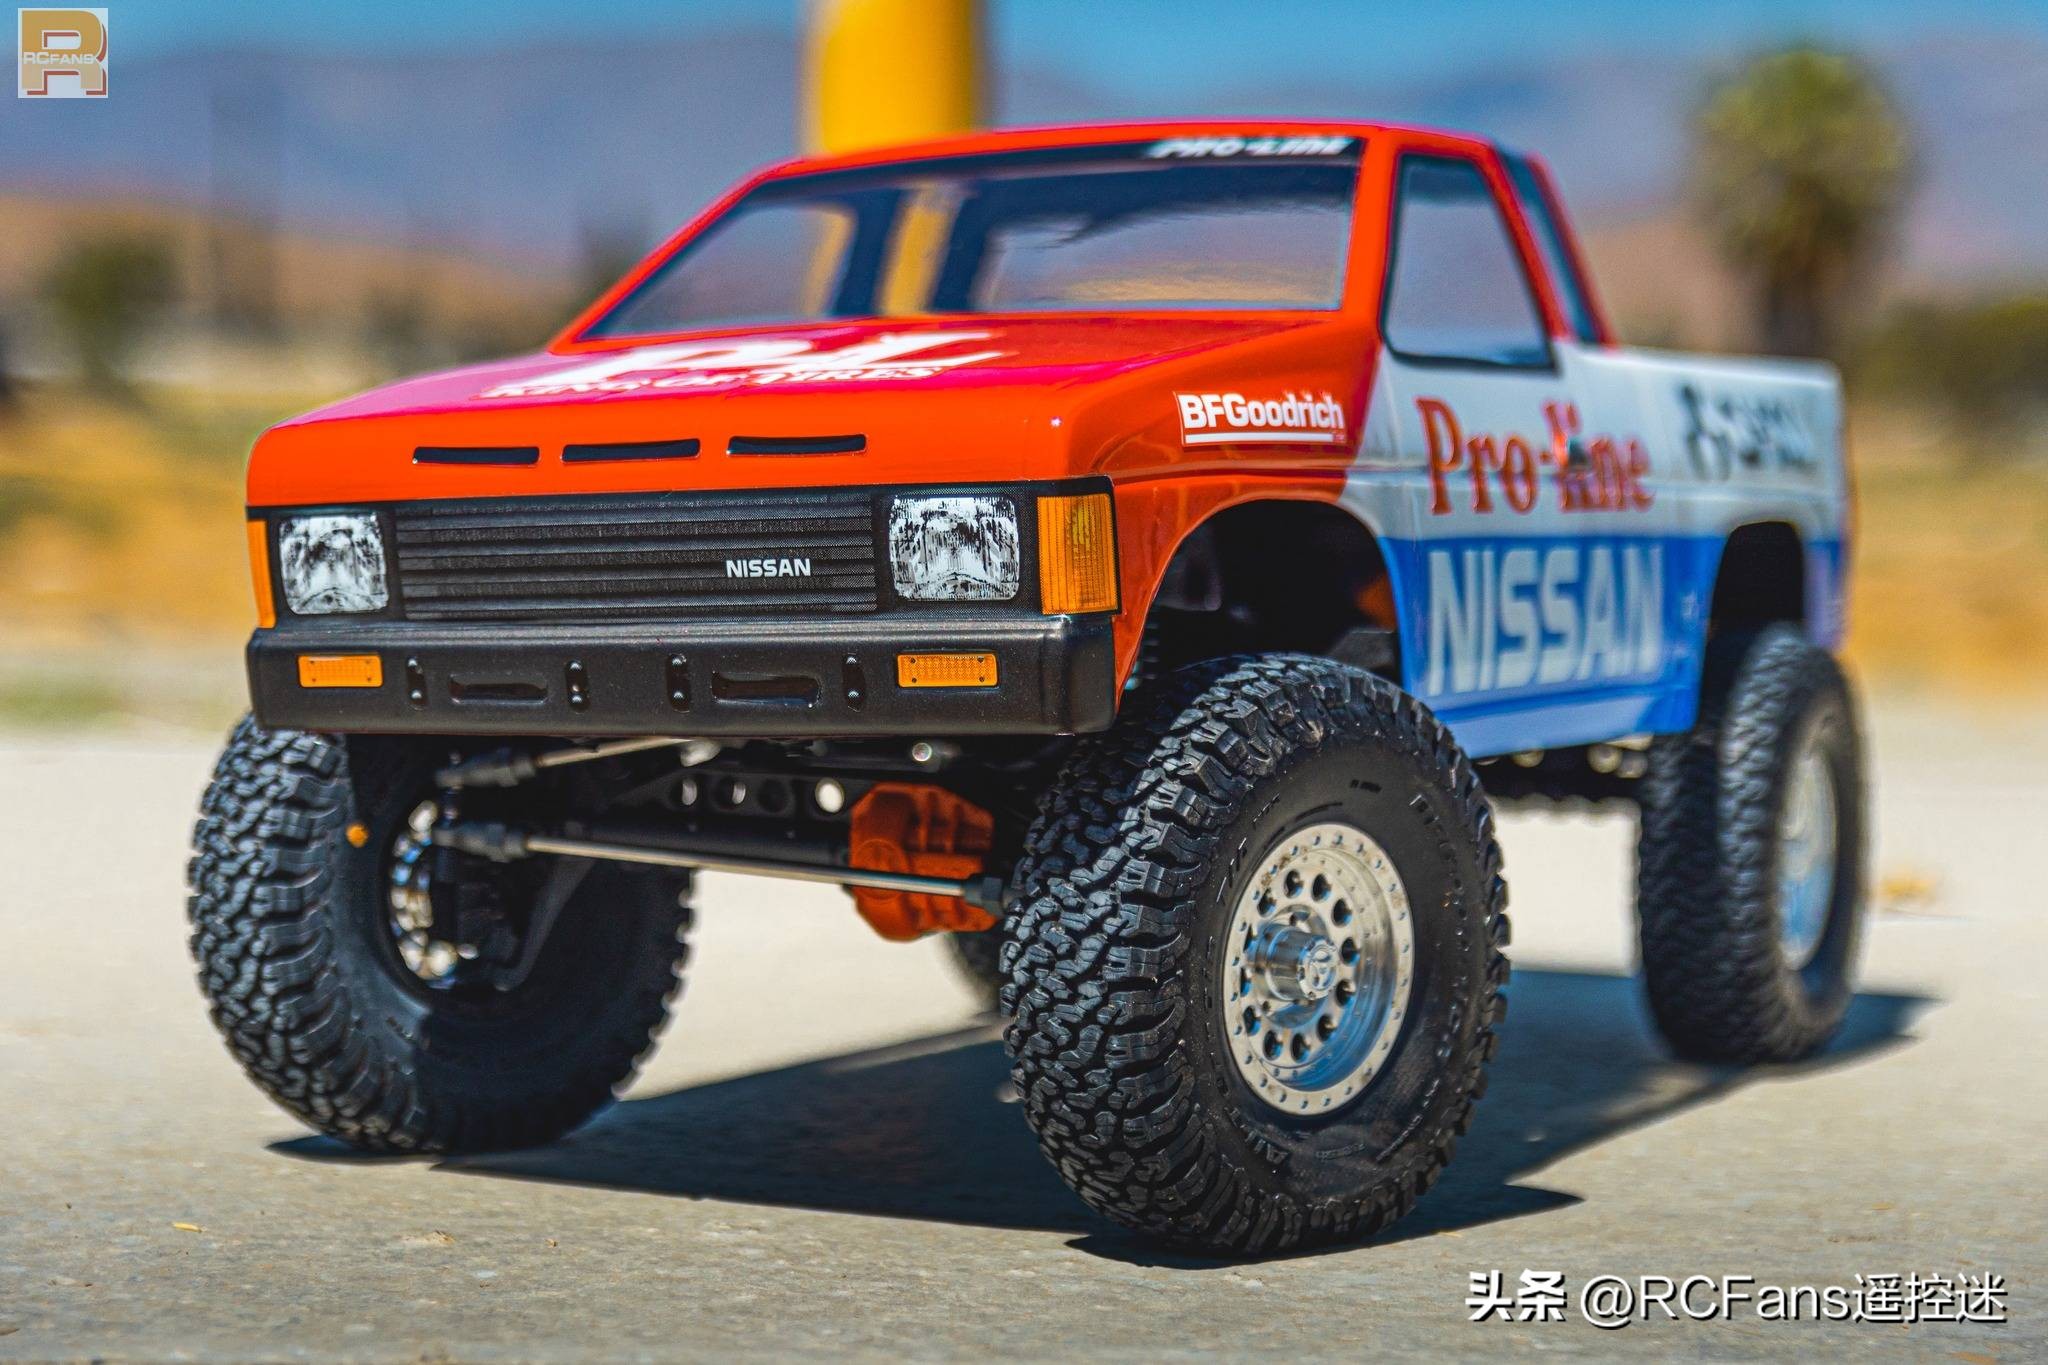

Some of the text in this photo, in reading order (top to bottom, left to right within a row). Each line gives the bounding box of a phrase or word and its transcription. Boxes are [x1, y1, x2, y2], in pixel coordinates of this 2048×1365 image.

[1177, 391, 1344, 430] BFGoodrich
[726, 558, 811, 578] NISSAN
[1427, 548, 1663, 696] NISSAN
